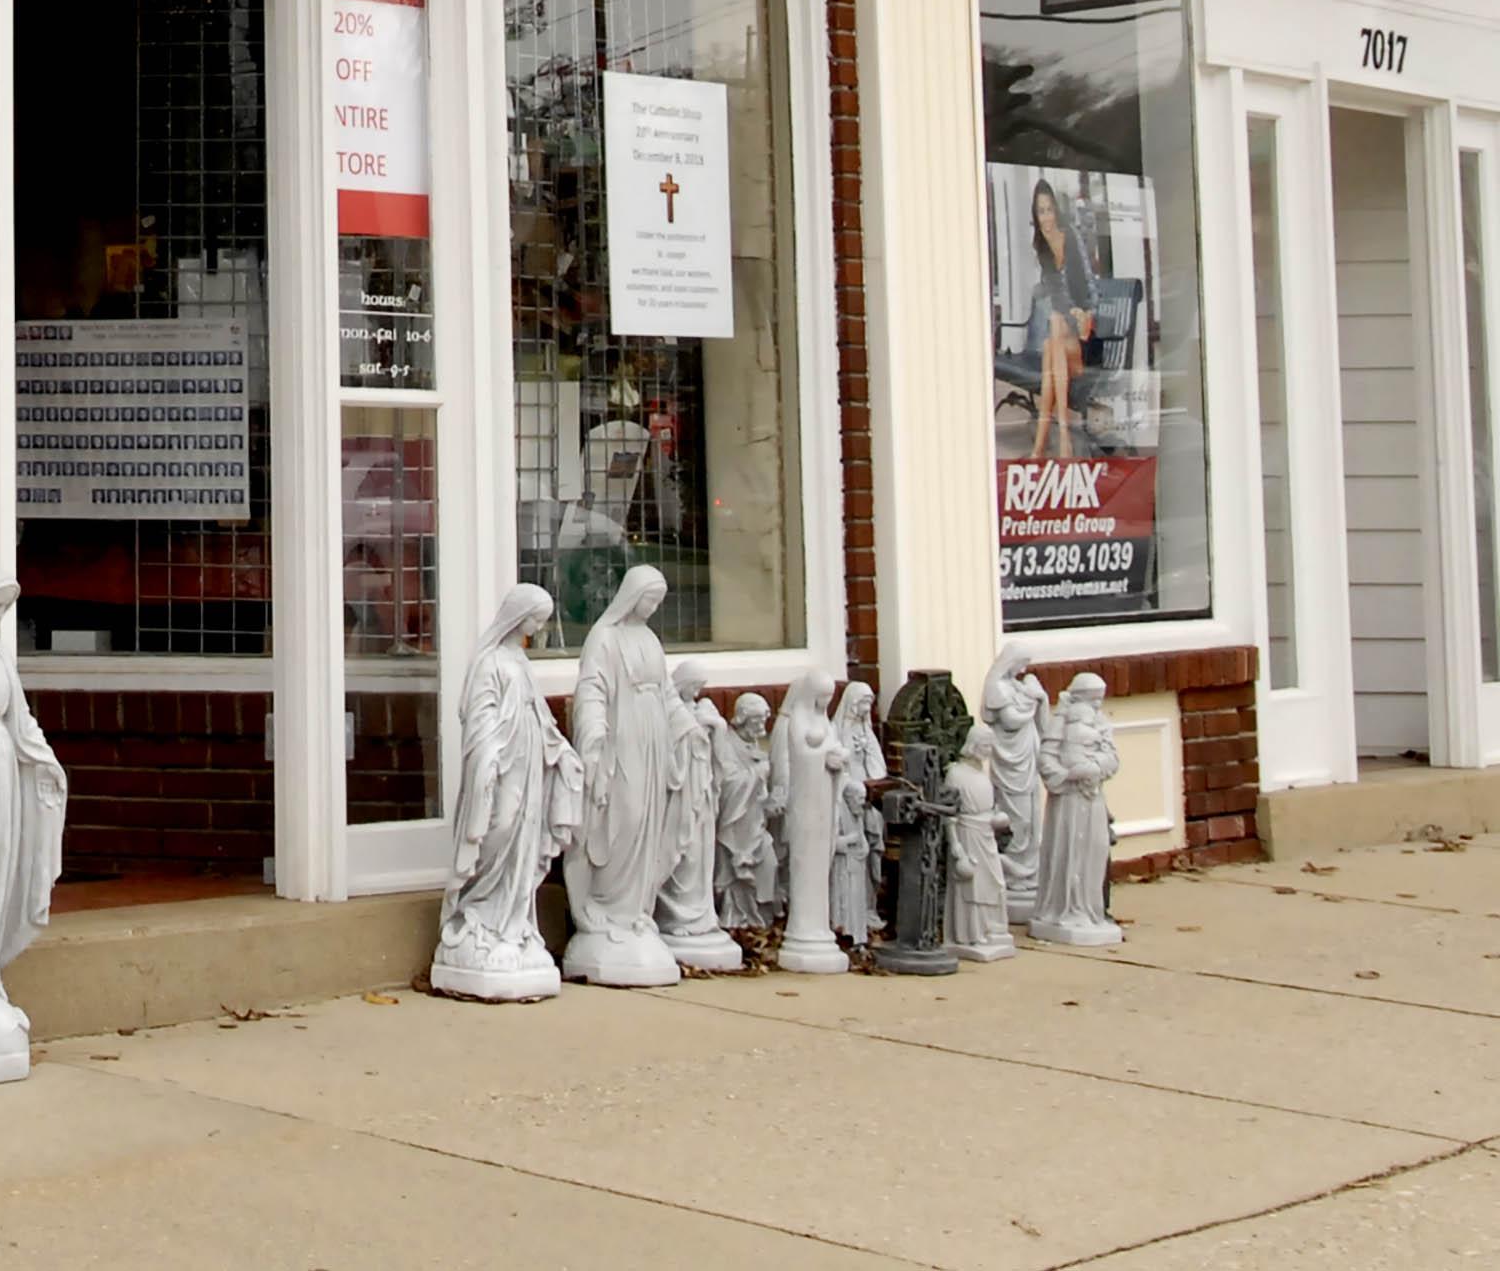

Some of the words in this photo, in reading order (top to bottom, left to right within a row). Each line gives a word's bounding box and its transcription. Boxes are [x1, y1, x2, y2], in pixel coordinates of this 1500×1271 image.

[334, 10, 374, 37] 20%
[1361, 27, 1408, 75] 7017
[336, 58, 373, 82] OFF
[336, 151, 388, 177] TORE
[406, 329, 432, 343] 10-6
[1001, 514, 1072, 537] Preferred
[1074, 512, 1117, 537] Group
[1000, 541, 1134, 577] 513.289.1039
